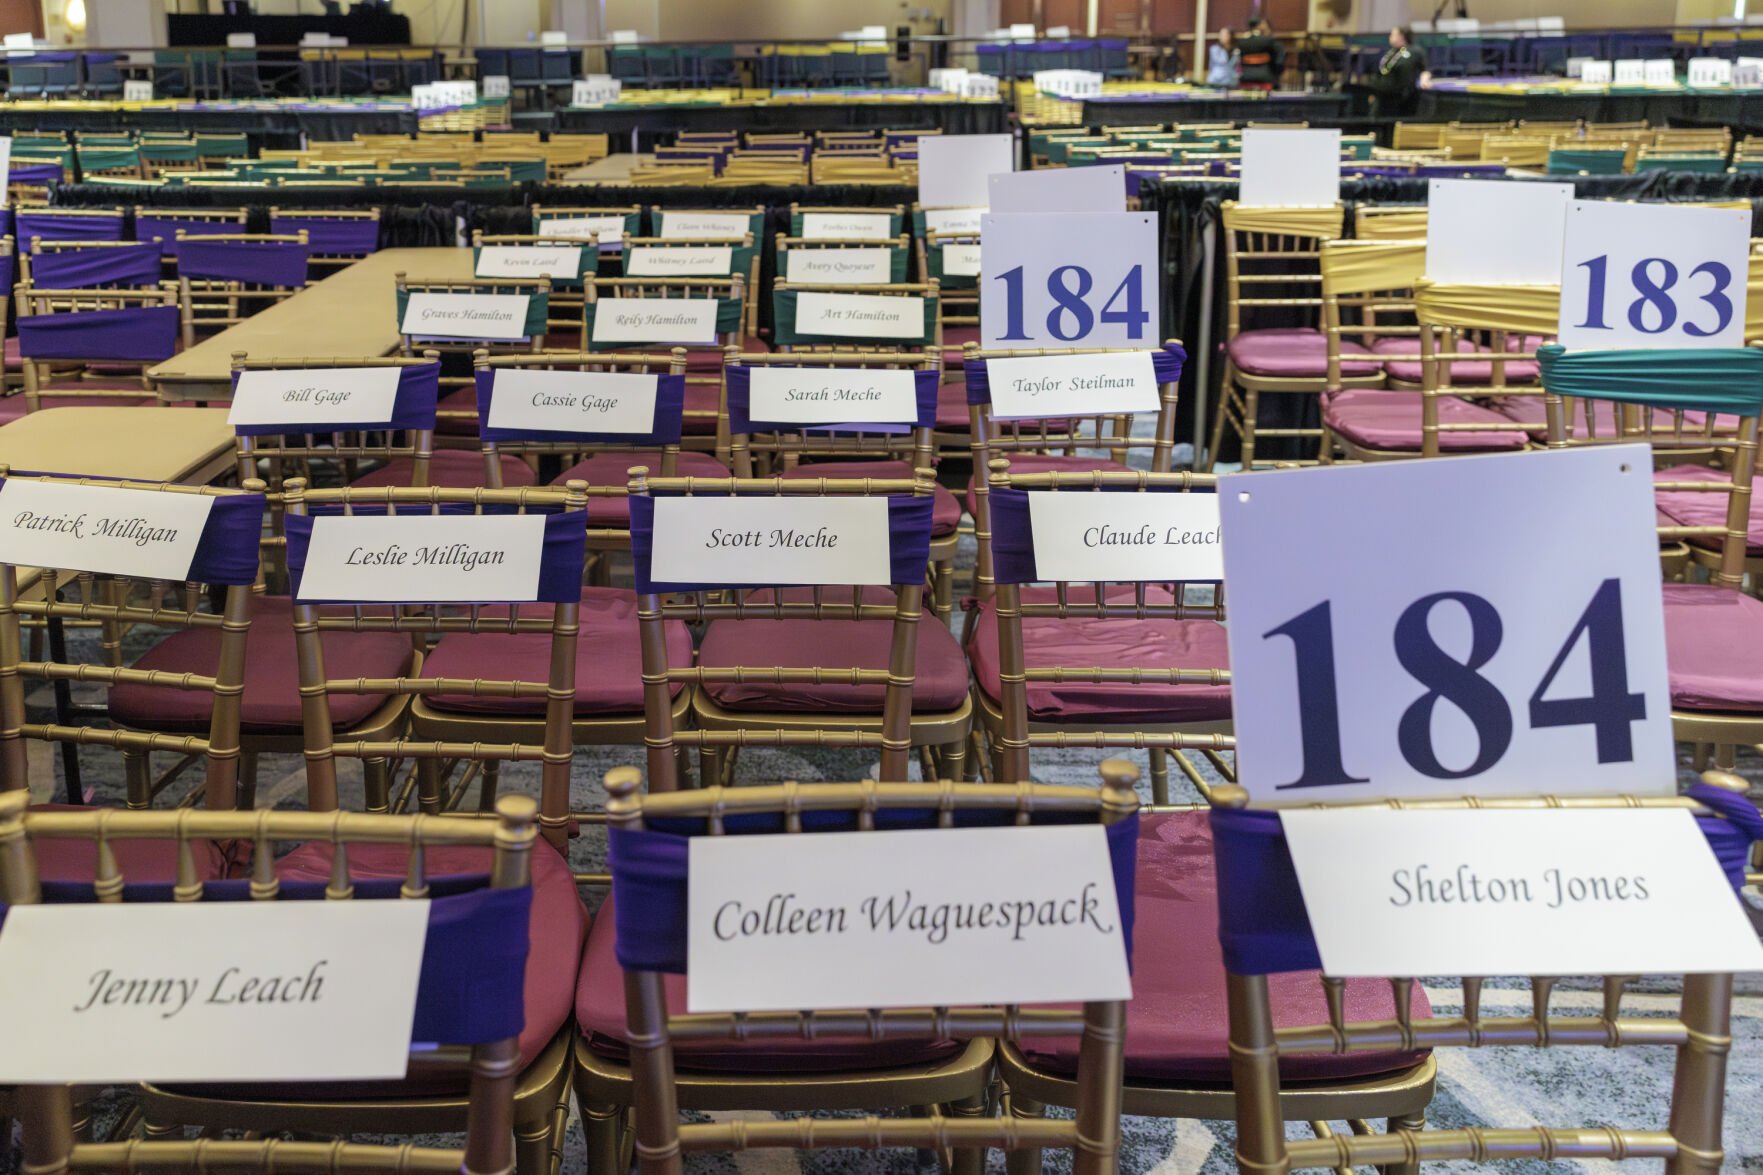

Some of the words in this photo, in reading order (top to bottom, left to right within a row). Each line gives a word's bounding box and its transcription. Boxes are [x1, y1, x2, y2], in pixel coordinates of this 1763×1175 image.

[802, 260, 832, 273] Avery
[994, 265, 1149, 341] 184
[1574, 255, 1733, 337] 183
[421, 308, 460, 321] Graves
[461, 309, 513, 321] Hamilton
[616, 314, 643, 327] Reily
[646, 314, 698, 325] Hamilton
[821, 309, 842, 319] Art
[846, 310, 900, 321] Hamilton
[785, 388, 828, 401] Sarah
[834, 387, 881, 400] Meche
[1012, 377, 1062, 395] Taylor
[1068, 373, 1136, 391] Steilman
[283, 388, 313, 401] Bill
[314, 389, 352, 405] Gage
[533, 393, 576, 406] Cassie
[582, 395, 618, 412] Gage
[14, 512, 86, 539] Patrick
[92, 518, 177, 546] Milligan
[706, 529, 762, 548] Scott
[769, 527, 837, 547] Meche
[1084, 525, 1155, 547] Claude
[344, 545, 407, 565] Leslie
[413, 544, 504, 571] Milligan
[1261, 578, 1647, 791] 184
[1389, 864, 1531, 907] Shelton
[1544, 869, 1649, 908] Jones
[714, 894, 845, 941] Colleen
[860, 882, 1115, 945] Waguespack
[74, 970, 198, 1019] Jenny
[207, 960, 328, 1004] Leach
